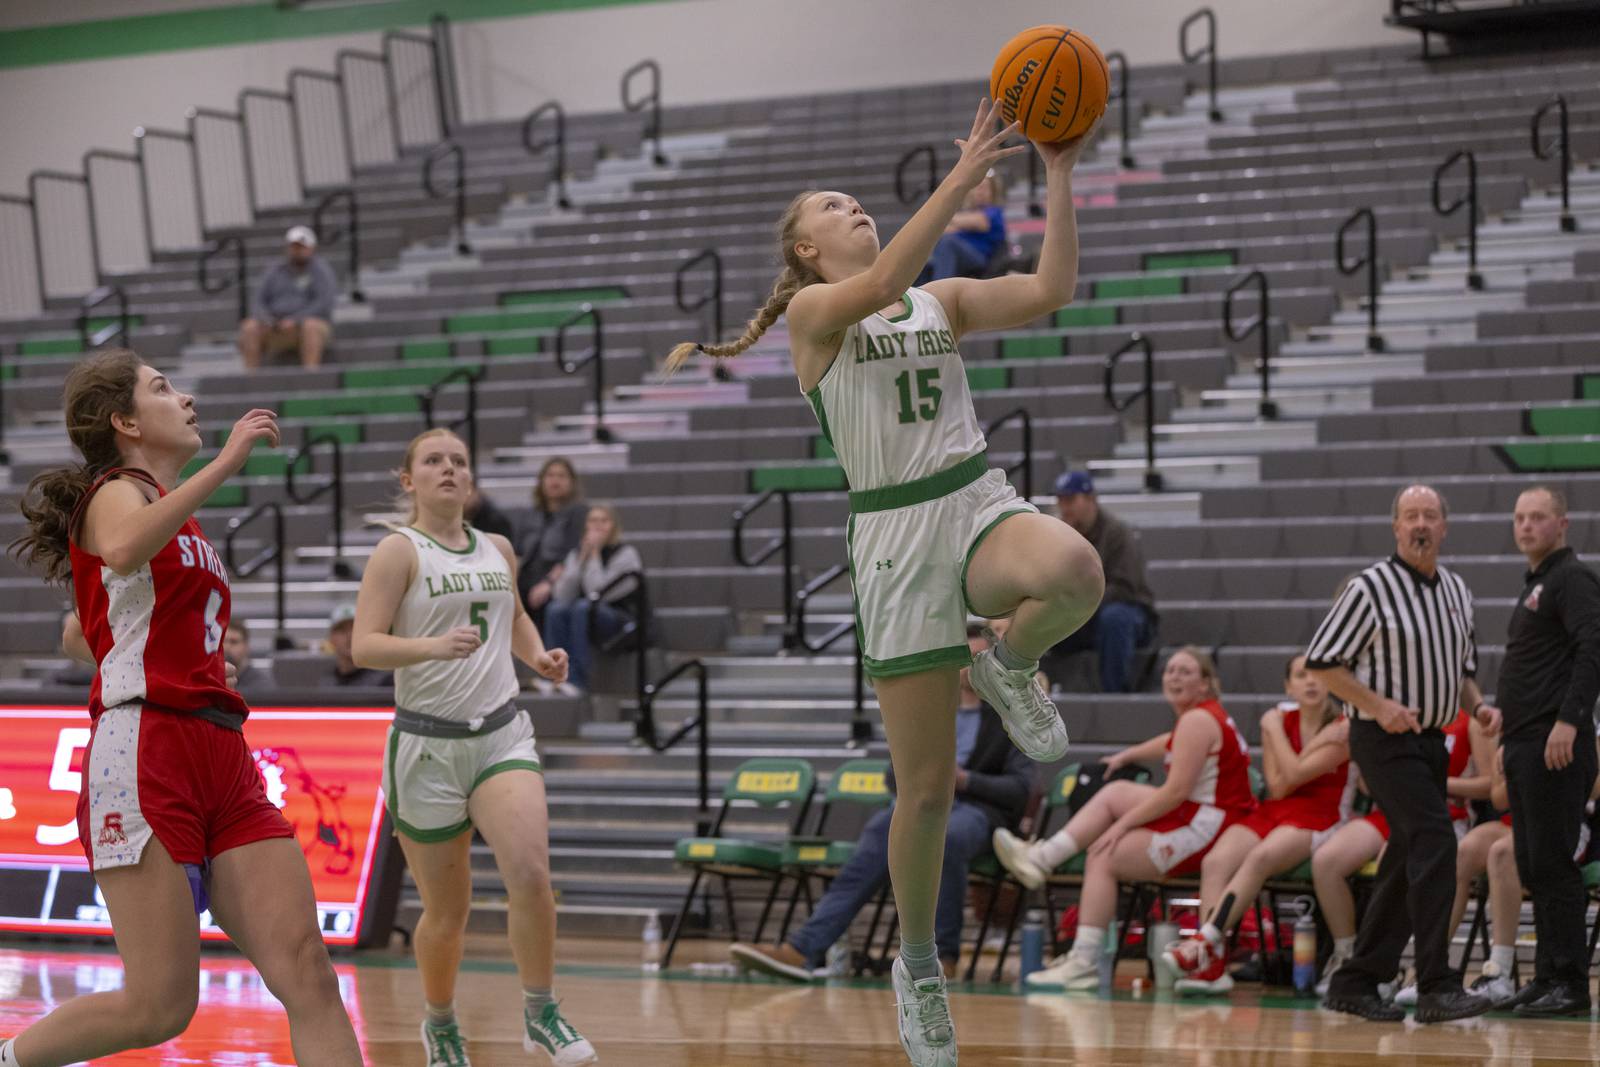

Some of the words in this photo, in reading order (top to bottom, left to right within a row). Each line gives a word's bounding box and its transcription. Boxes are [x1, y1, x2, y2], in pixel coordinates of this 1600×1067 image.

[1002, 60, 1039, 122] Wilson
[854, 331, 907, 364] LADY
[895, 367, 943, 424] 15
[425, 573, 474, 598] LADY
[470, 601, 489, 645] 5
[35, 728, 91, 845] 5
